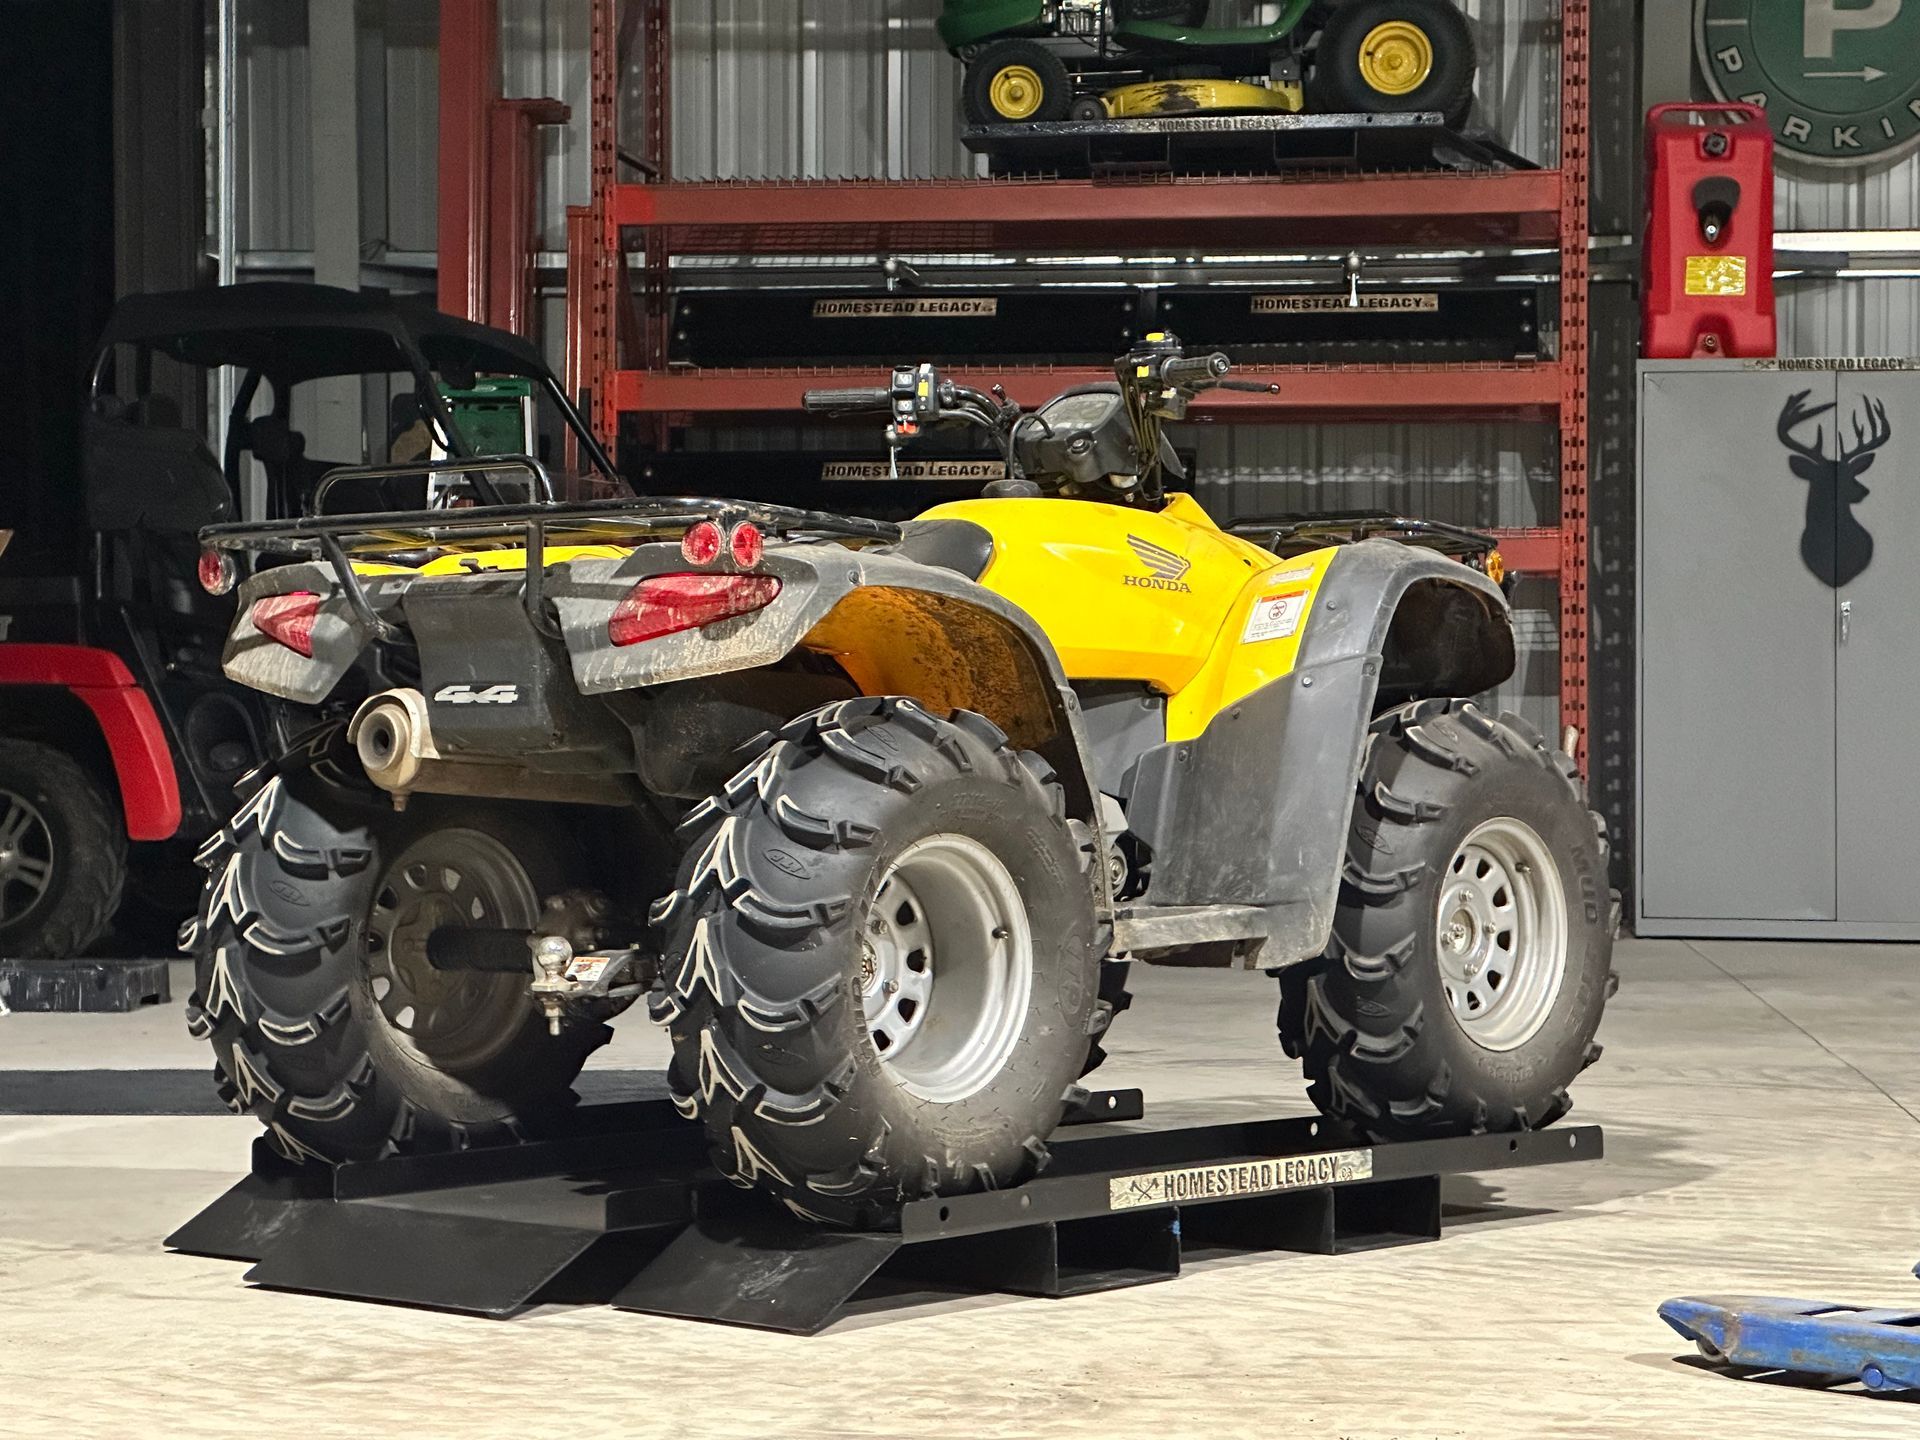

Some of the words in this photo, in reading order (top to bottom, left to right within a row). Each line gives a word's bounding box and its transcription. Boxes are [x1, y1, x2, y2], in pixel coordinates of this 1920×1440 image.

[1158, 118, 1232, 131] HOMESTEAD
[816, 302, 915, 314] HOMESTEAD
[919, 302, 982, 313] LEGACY
[1359, 297, 1422, 308] LEGACY
[1779, 358, 1855, 369] HOMESTEAD
[1857, 357, 1904, 369] LEGACY
[928, 464, 991, 476] LEGACY
[1122, 575, 1192, 593] HONDA
[1163, 1162, 1273, 1199] HOMESTEAD
[1276, 1156, 1339, 1186] LEGACY
